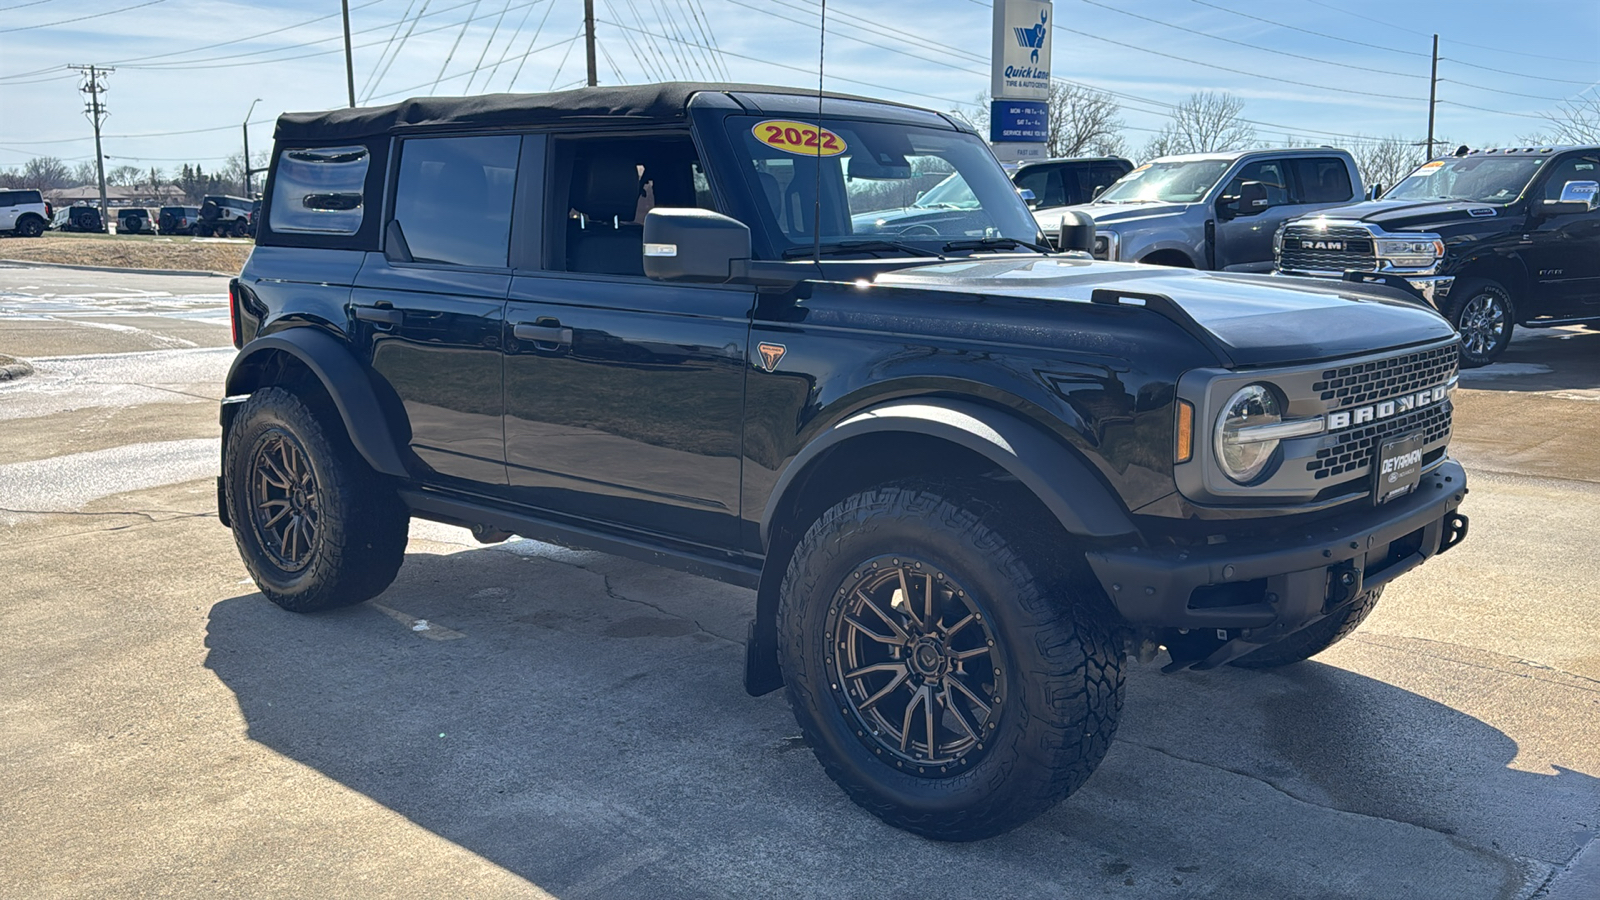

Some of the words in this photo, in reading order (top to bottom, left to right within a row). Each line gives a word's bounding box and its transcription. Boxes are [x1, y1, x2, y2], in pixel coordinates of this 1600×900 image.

[1005, 65, 1032, 78] Quick
[1032, 67, 1049, 80] Lane
[765, 125, 840, 151] 2022
[1301, 240, 1342, 250] RAM
[1328, 385, 1446, 430] BRONCO
